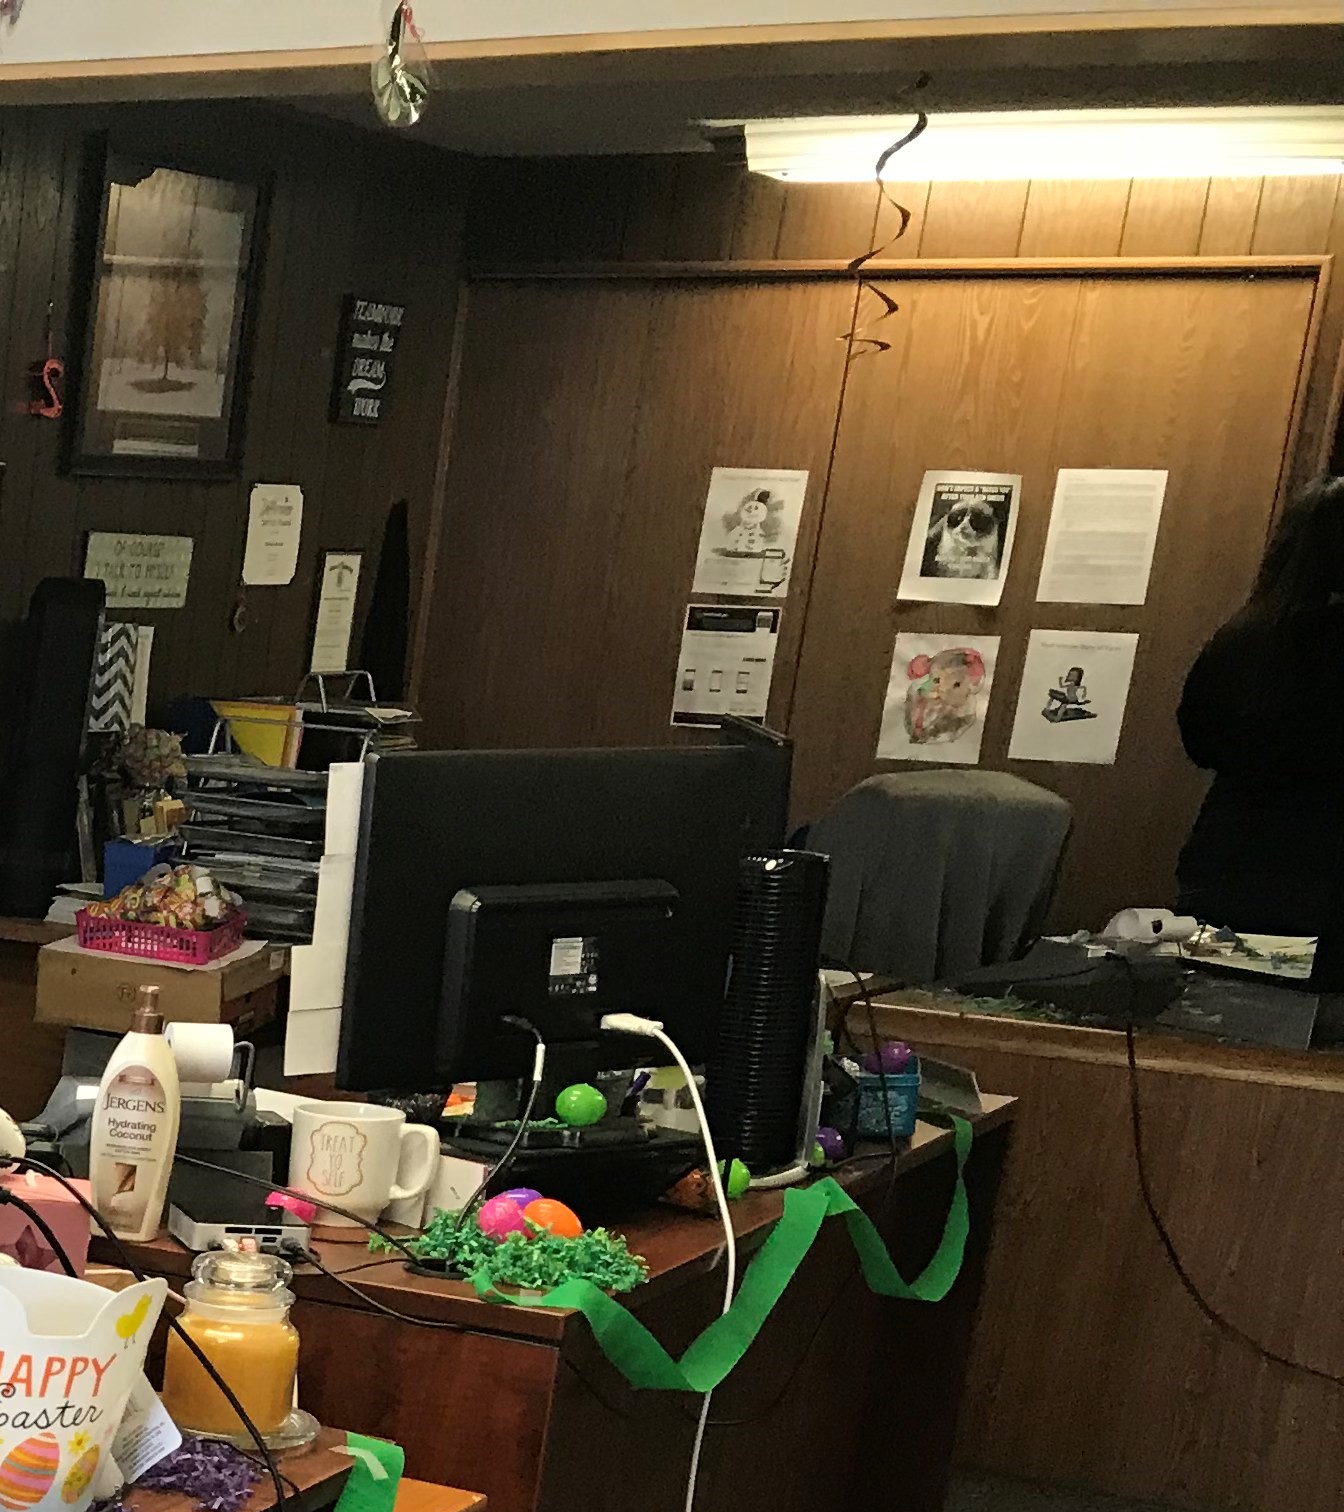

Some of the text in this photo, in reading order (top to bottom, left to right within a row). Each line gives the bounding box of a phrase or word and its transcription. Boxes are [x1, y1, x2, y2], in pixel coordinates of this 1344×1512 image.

[103, 1093, 165, 1114] JERGENS
[107, 1118, 157, 1133] Hydrating
[109, 1129, 153, 1142] Coconut
[321, 1134, 355, 1153] TREAT
